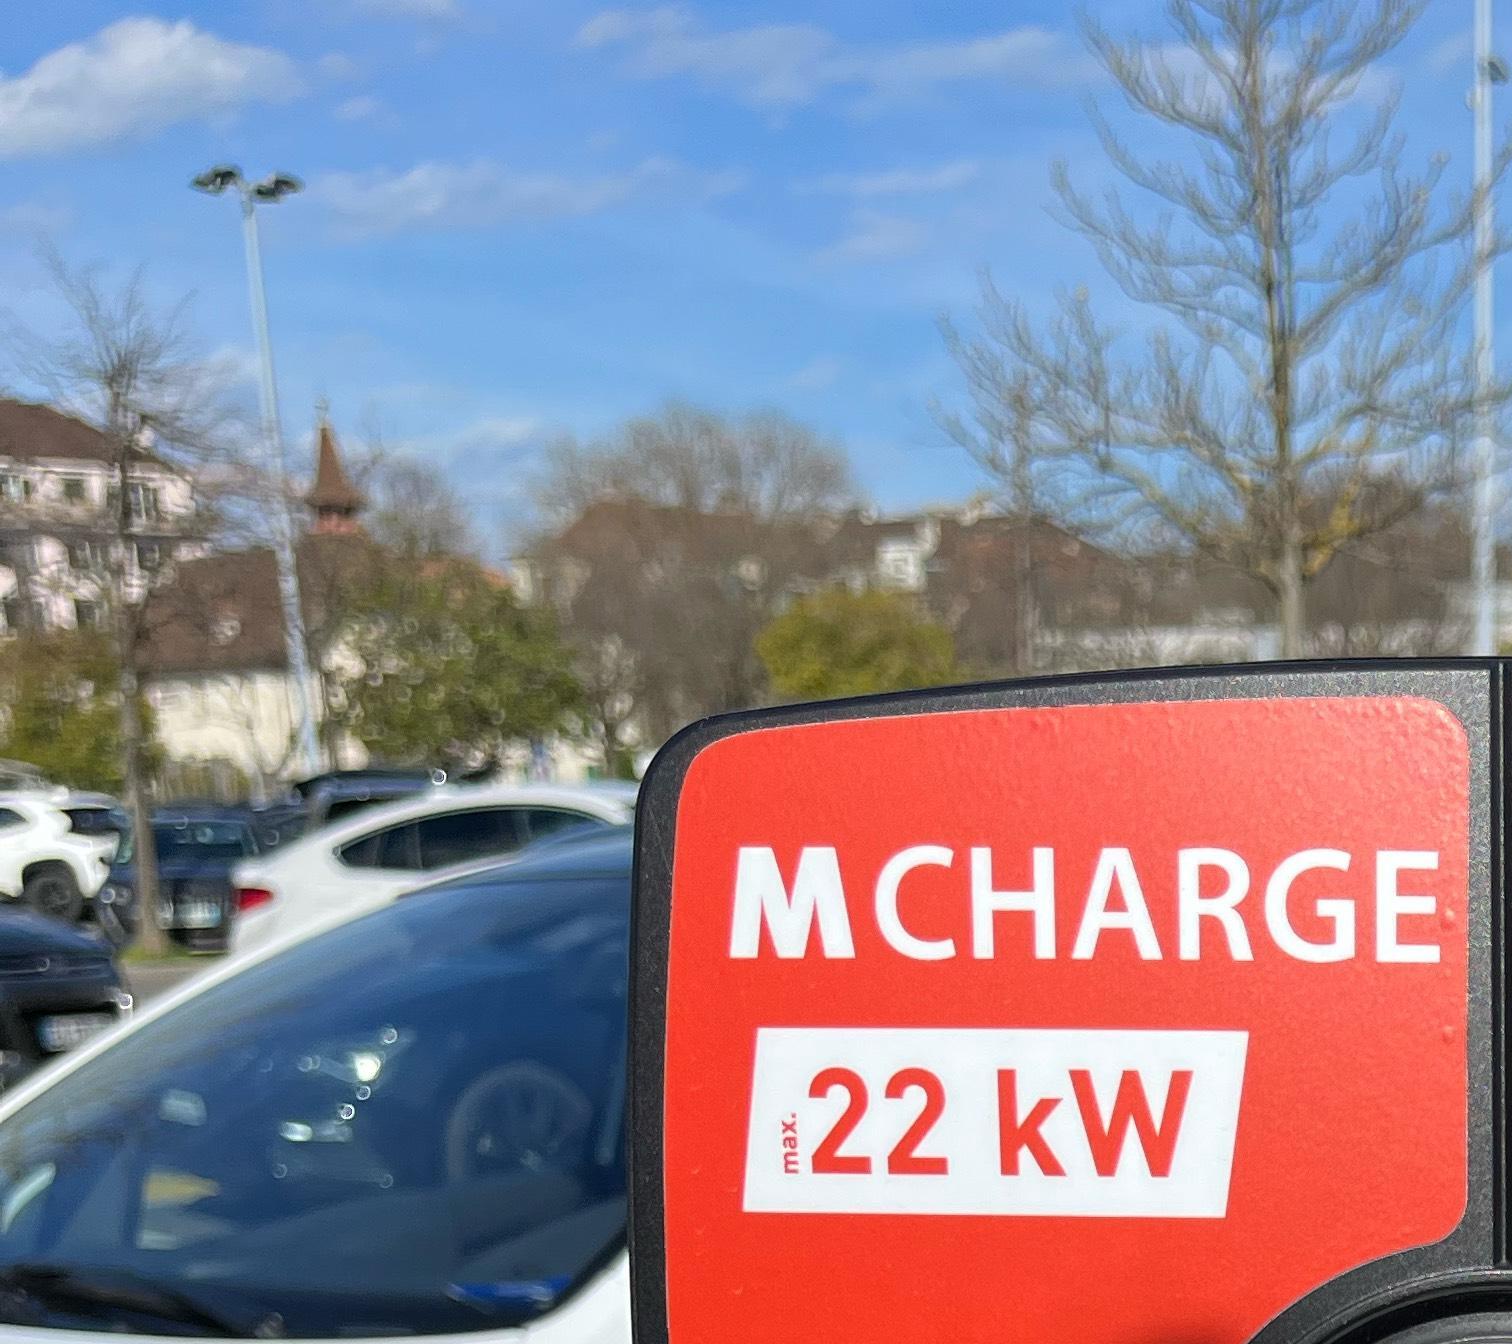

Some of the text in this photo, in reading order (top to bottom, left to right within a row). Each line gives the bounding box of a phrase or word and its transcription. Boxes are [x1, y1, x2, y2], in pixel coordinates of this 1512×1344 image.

[781, 1113, 800, 1176] max.
[808, 1067, 1193, 1177] 22 kW
